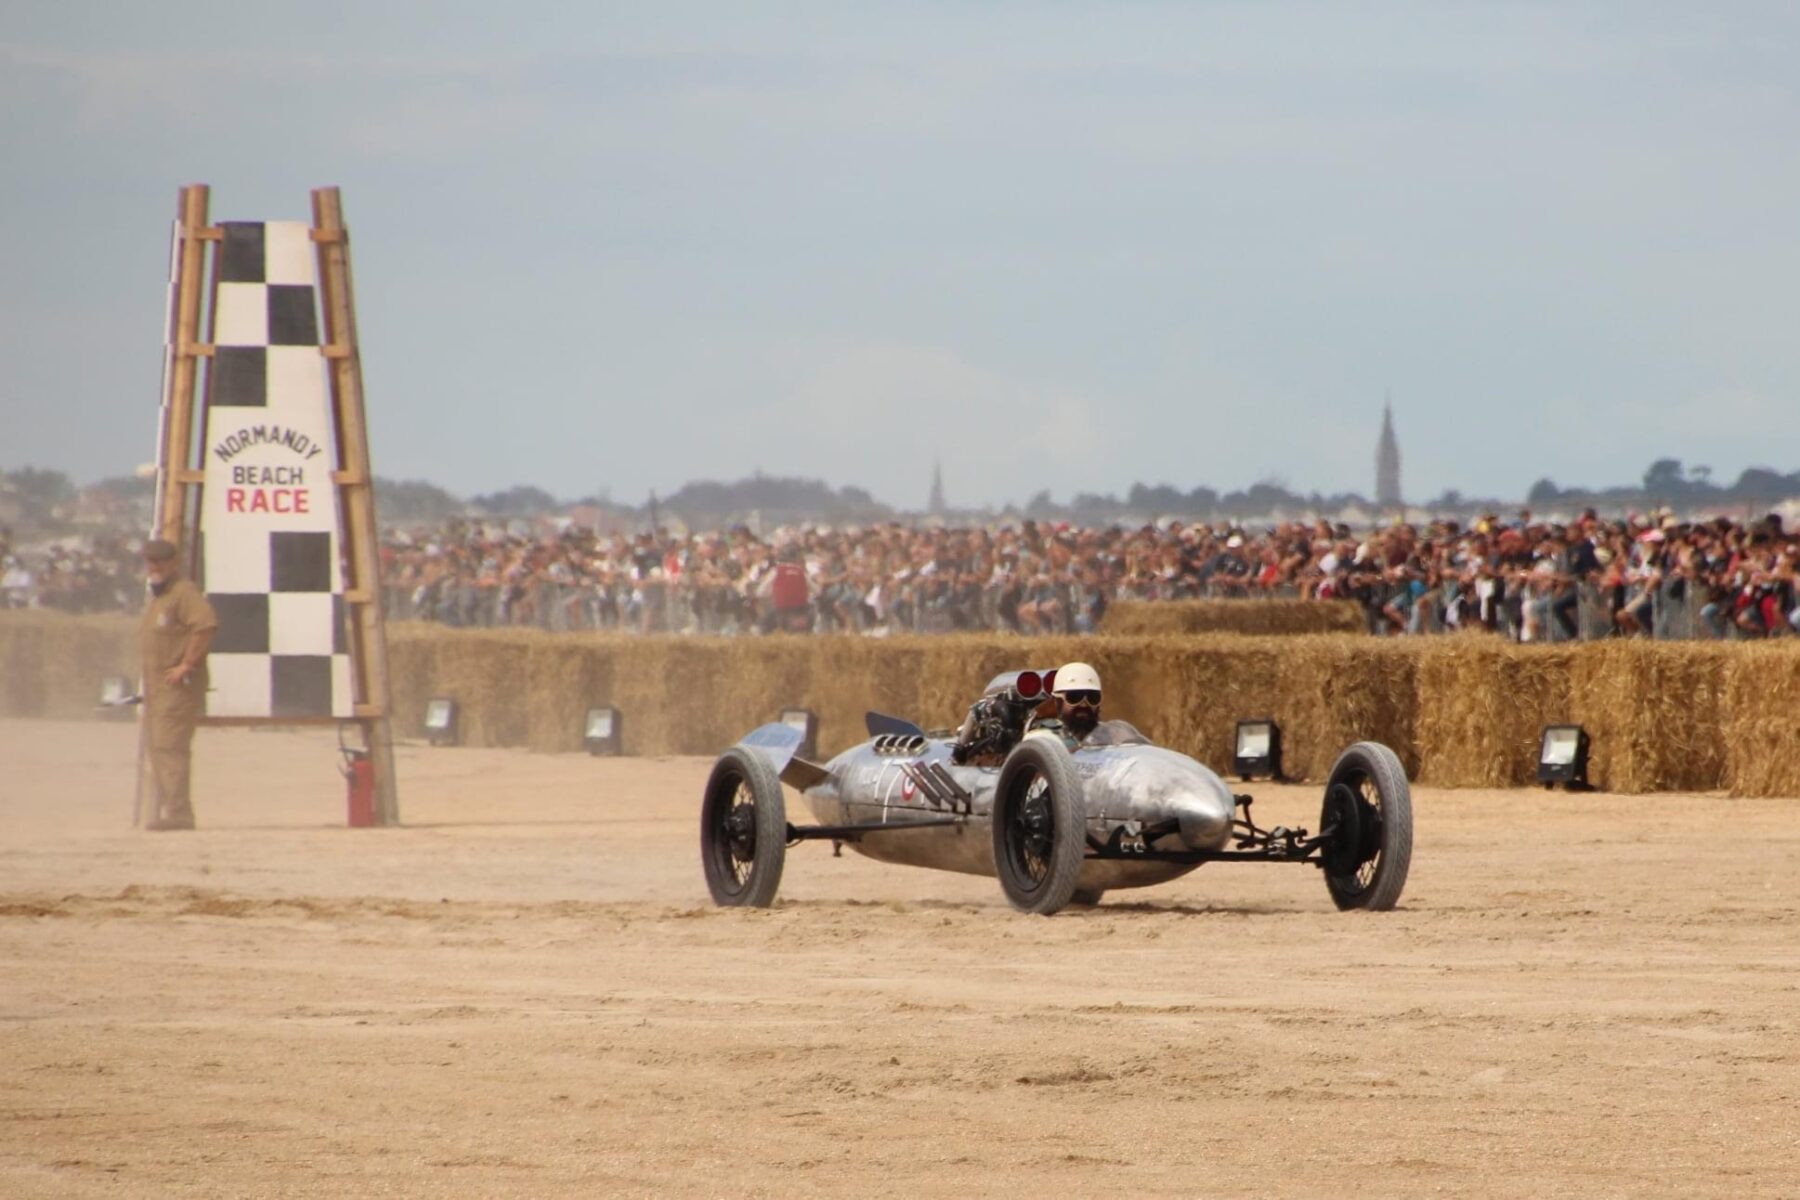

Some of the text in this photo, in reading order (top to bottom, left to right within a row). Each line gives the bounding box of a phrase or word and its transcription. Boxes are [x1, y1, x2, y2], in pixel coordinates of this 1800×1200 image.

[214, 425, 322, 462] NORMANDY
[233, 466, 303, 485] BEACH
[227, 488, 309, 513] RACE
